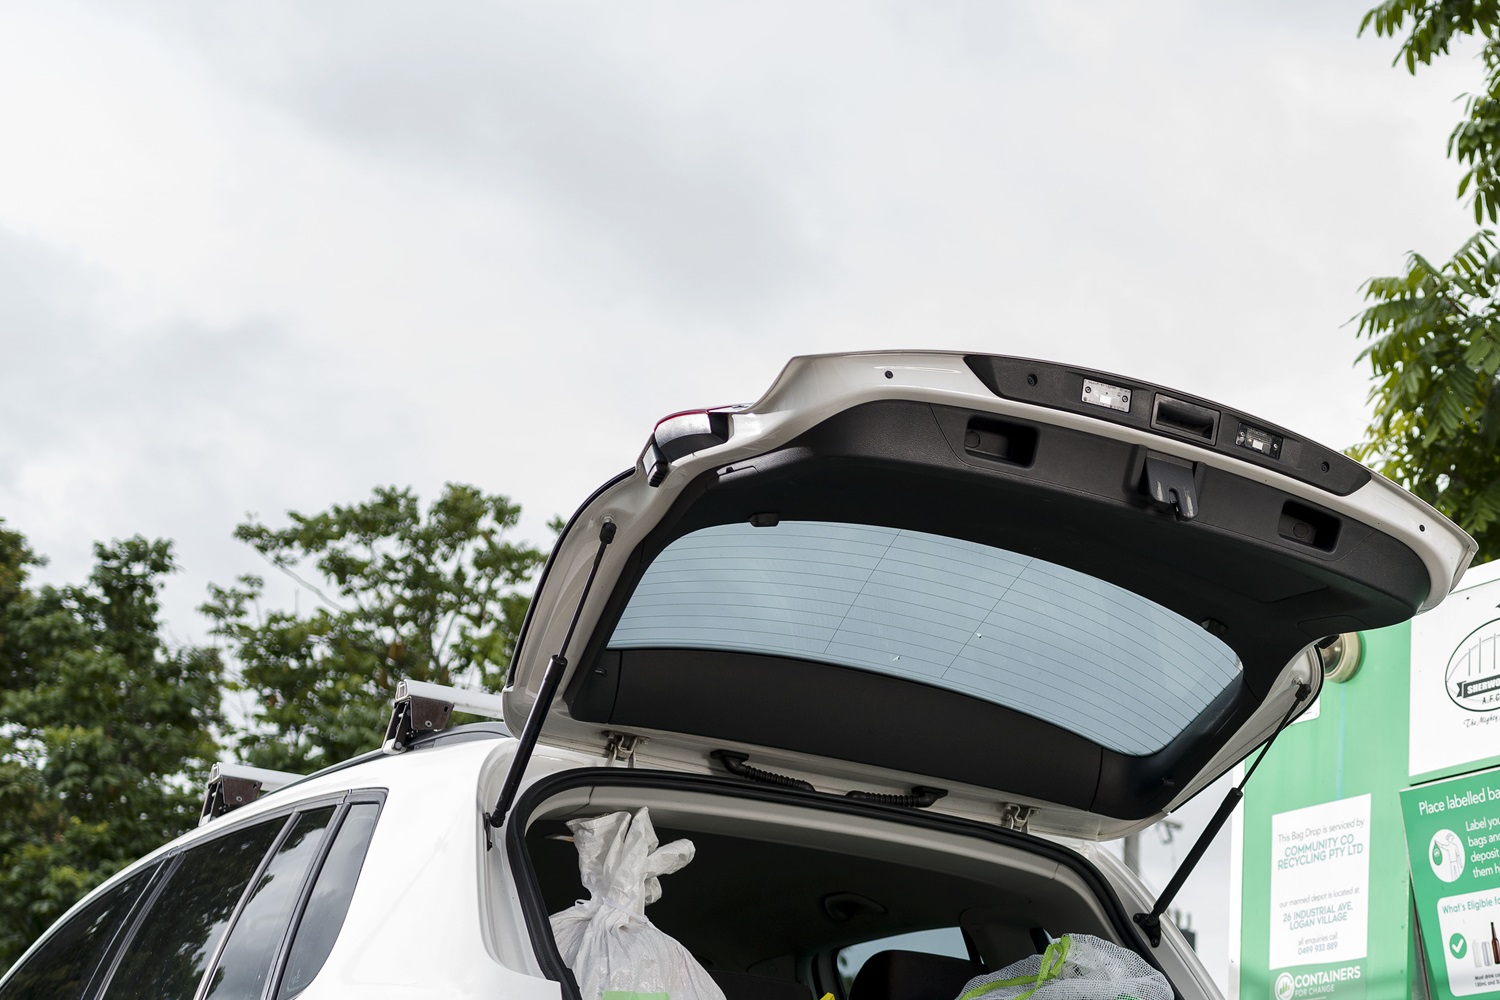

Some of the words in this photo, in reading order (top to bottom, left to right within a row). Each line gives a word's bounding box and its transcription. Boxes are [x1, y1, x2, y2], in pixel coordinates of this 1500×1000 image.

[1419, 801, 1445, 815] Place
[1446, 788, 1486, 809] labelled
[1465, 817, 1486, 831] Label
[1285, 836, 1338, 857] COMMUNITY
[1340, 833, 1354, 846] CO
[1467, 836, 1487, 848] bags
[1278, 851, 1326, 870] RECYCLING
[1329, 846, 1345, 859] PTY
[1348, 843, 1363, 856] LTD
[1470, 848, 1500, 863] deposit
[1472, 866, 1494, 878] them
[1442, 903, 1466, 914] What's
[1467, 898, 1493, 911] Eligible
[1294, 965, 1361, 988] CONTAINERS
[1295, 987, 1307, 997] FOR
[1308, 984, 1335, 996] CHANGE
